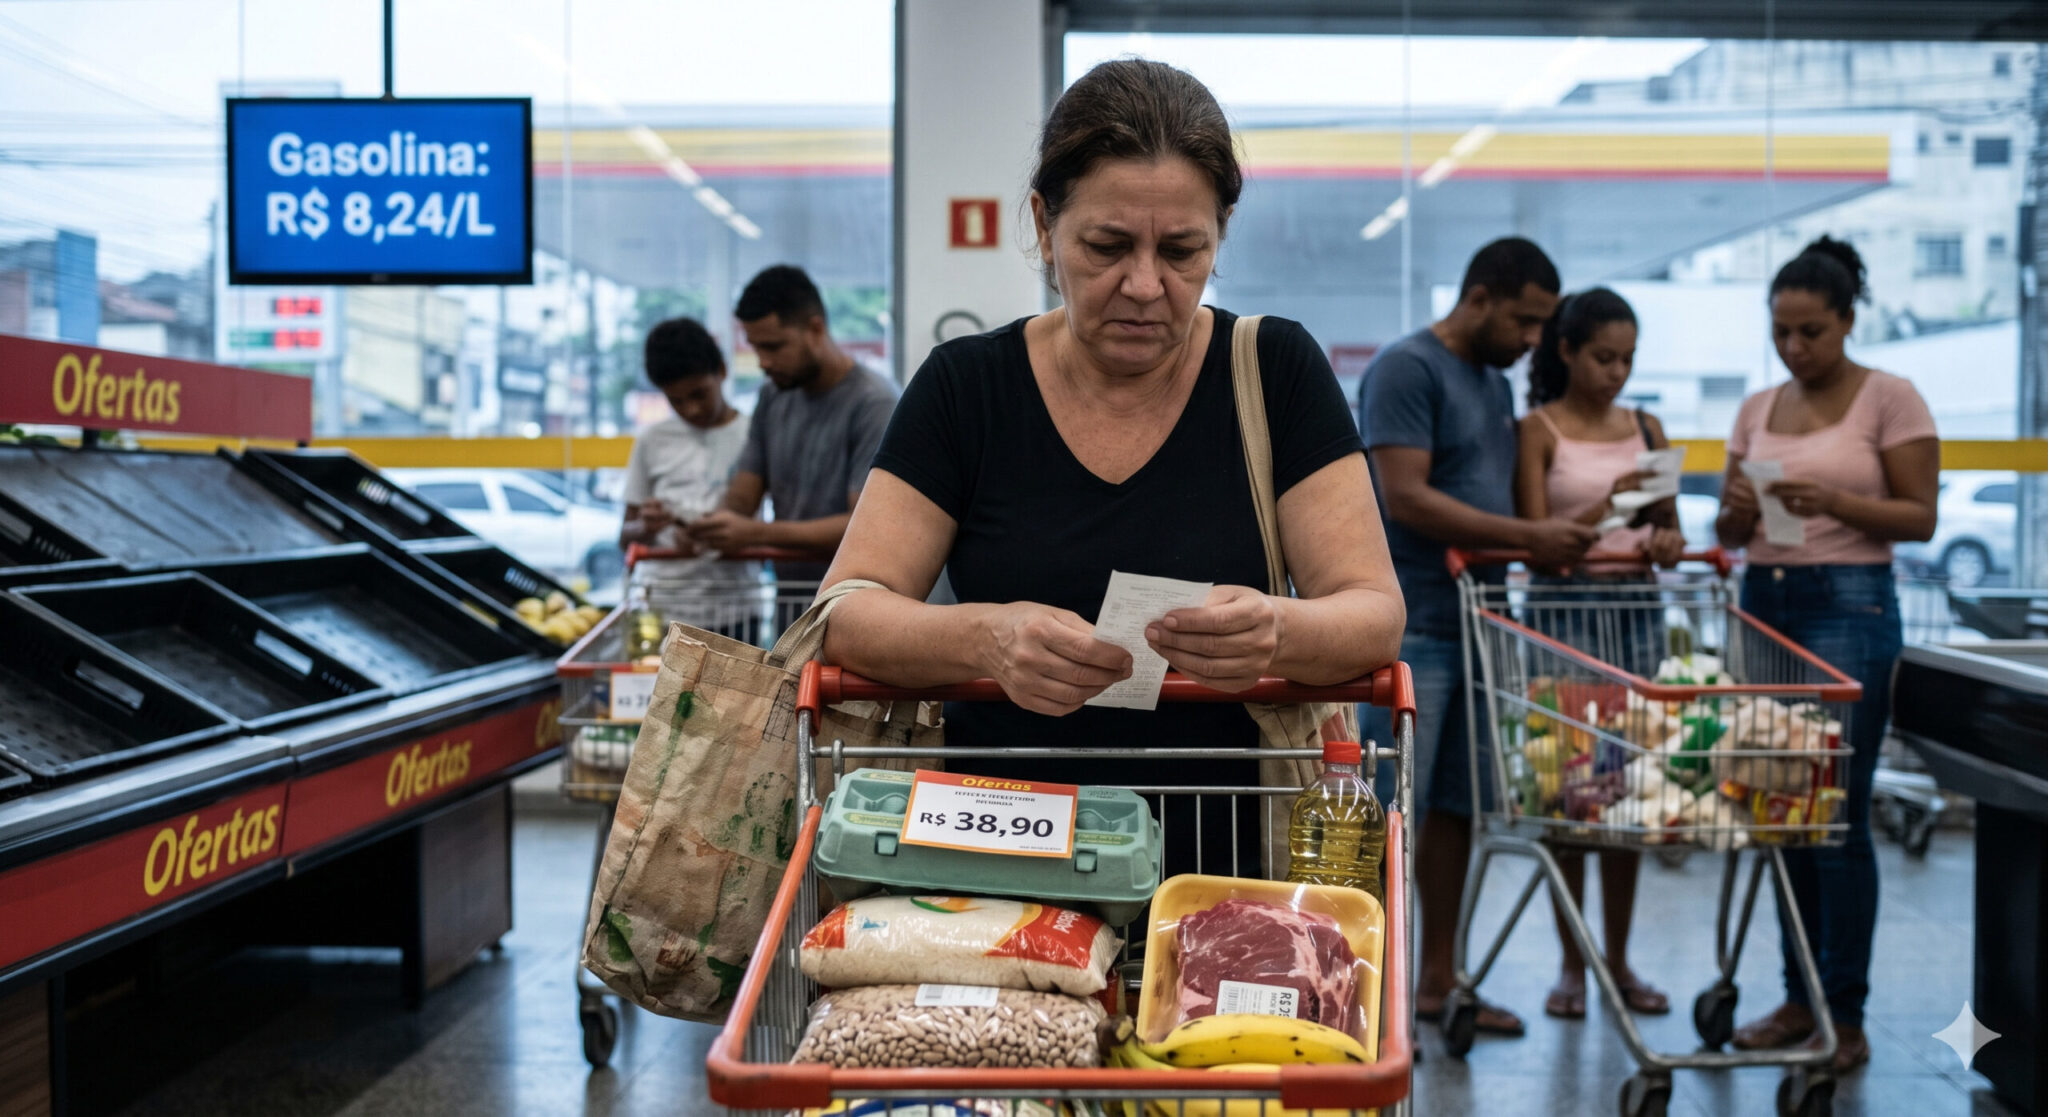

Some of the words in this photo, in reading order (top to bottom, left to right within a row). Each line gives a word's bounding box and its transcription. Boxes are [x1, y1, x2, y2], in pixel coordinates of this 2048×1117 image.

[268, 131, 490, 176] Gasolina:
[266, 188, 330, 239] R$
[343, 191, 495, 242] 8,24/L
[52, 354, 181, 424] Ofertas
[385, 741, 471, 807] Ofertas
[961, 777, 1032, 791] Ofertas
[143, 803, 279, 897] Ofertas
[919, 812, 946, 826] R$
[954, 811, 1054, 838] 38,90
